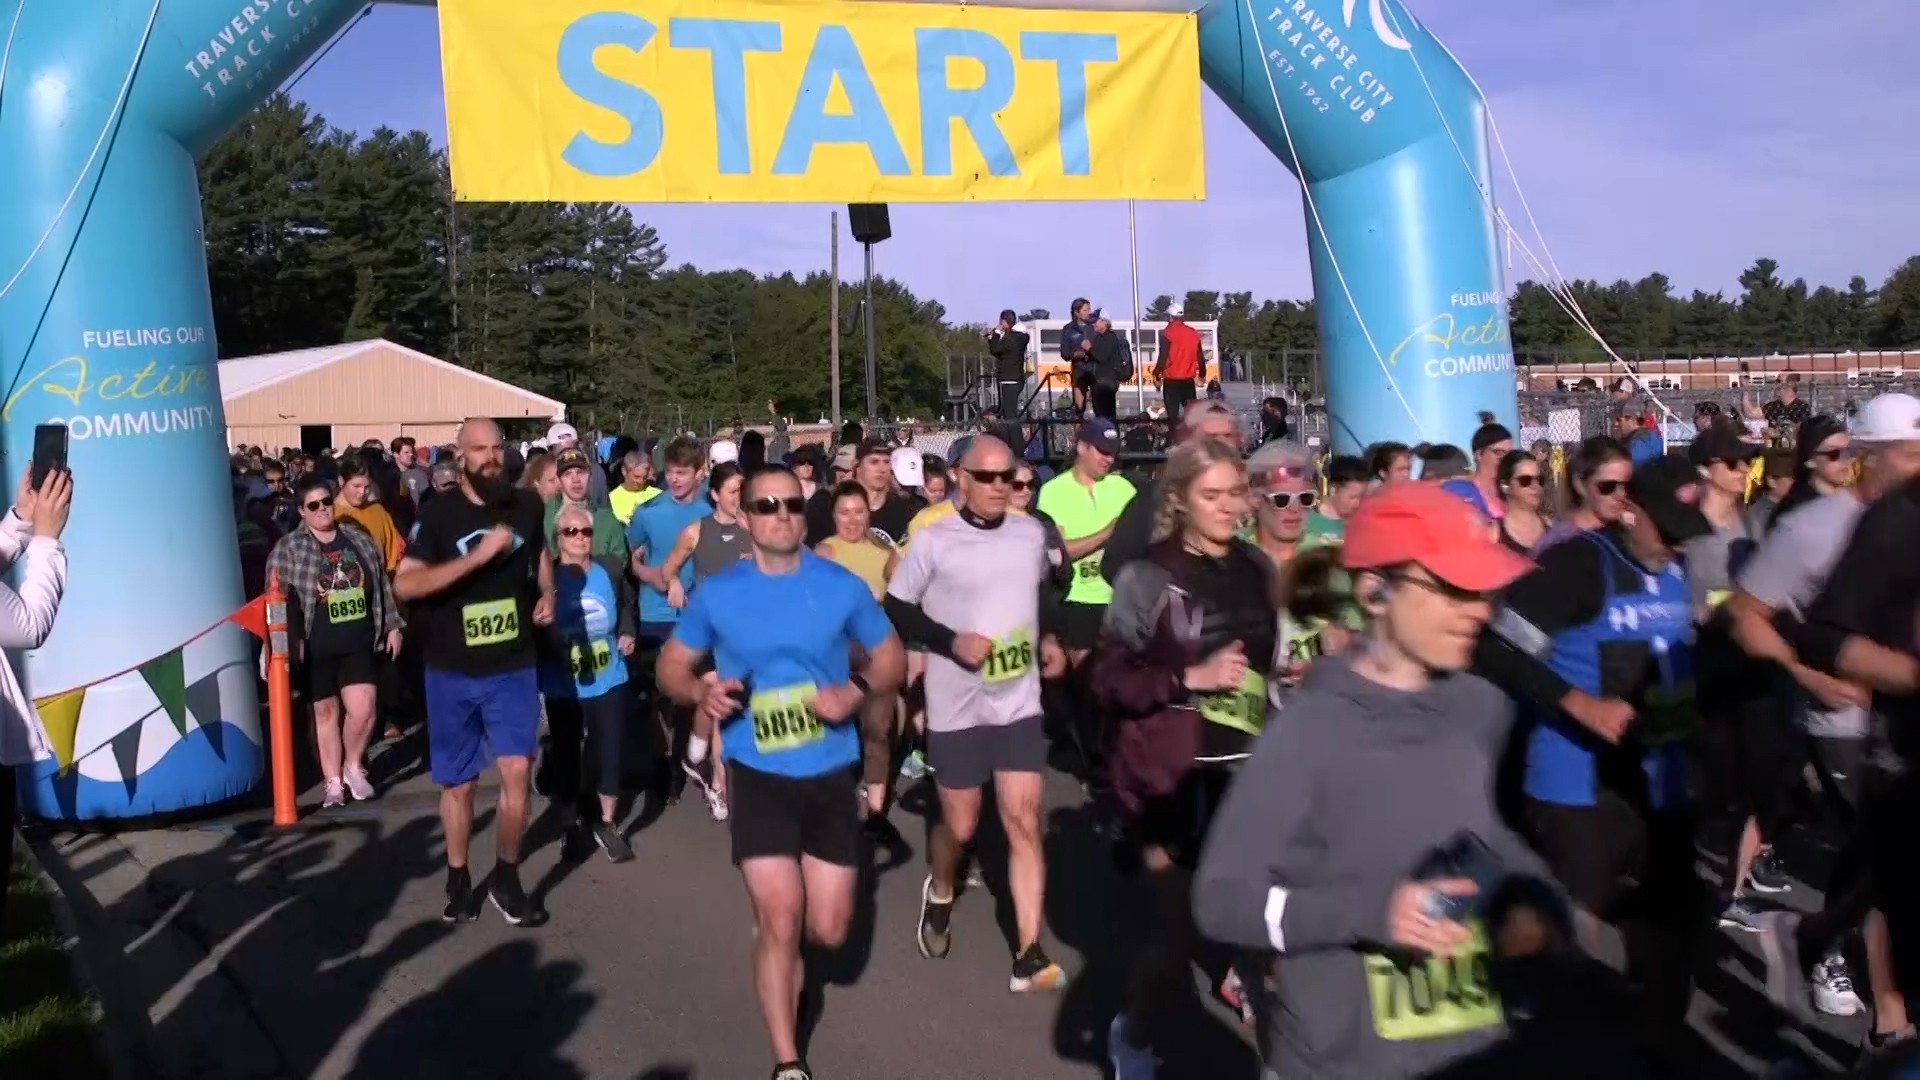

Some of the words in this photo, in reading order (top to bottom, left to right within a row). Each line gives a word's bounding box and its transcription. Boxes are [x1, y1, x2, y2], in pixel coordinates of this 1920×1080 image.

[185, 0, 278, 78] TRAVERS
[203, 25, 276, 97] TRACK
[1267, 7, 1326, 70] TRACK
[1330, 75, 1375, 122] CLUB
[1285, 0, 1358, 70] RAVERSE
[1358, 71, 1394, 107] CITY
[556, 11, 1118, 178] START
[1299, 80, 1330, 113] 1962
[1451, 291, 1500, 308] FUELING
[83, 327, 171, 348] FUELING
[176, 326, 205, 345] OUR
[2, 354, 208, 423] Active
[1424, 353, 1513, 378] COMMUN
[330, 597, 366, 618] 6839
[466, 611, 517, 638] 5824
